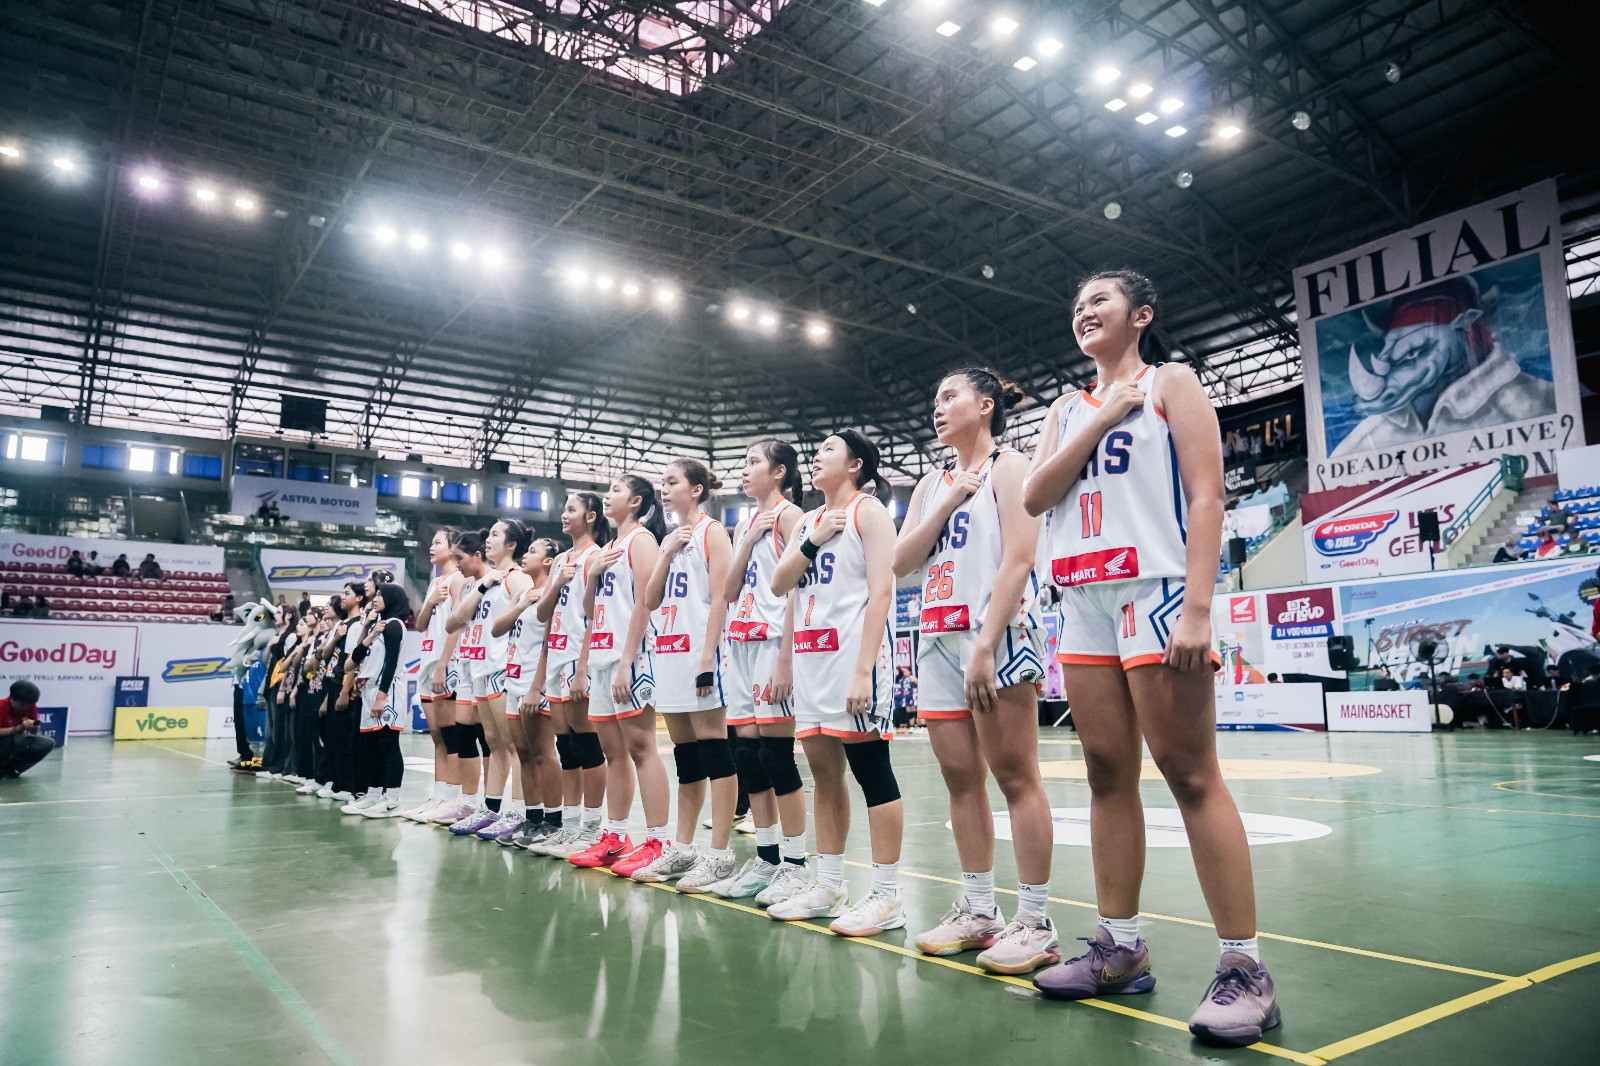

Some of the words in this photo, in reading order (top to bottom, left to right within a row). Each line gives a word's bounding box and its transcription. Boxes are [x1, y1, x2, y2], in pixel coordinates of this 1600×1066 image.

[1302, 201, 1551, 321] FILIAL
[1330, 453, 1392, 479] DEAD
[1412, 441, 1448, 463] OR
[1467, 420, 1556, 453] ALIVE
[280, 493, 317, 505] ASTRA
[320, 497, 360, 508] MOTOR
[1080, 491, 1103, 539] 11
[1334, 521, 1379, 533] HONDA
[11, 543, 57, 559] Good
[1335, 536, 1357, 549] DBL
[925, 561, 954, 603] 26
[1056, 574, 1070, 584] One
[804, 594, 815, 626] 1
[1286, 597, 1311, 611] LET'S
[1121, 601, 1136, 638] 11
[1296, 606, 1324, 623] LOUD
[0, 641, 66, 662] Good
[69, 642, 117, 669] Day
[1341, 704, 1411, 718] MAINBASKET
